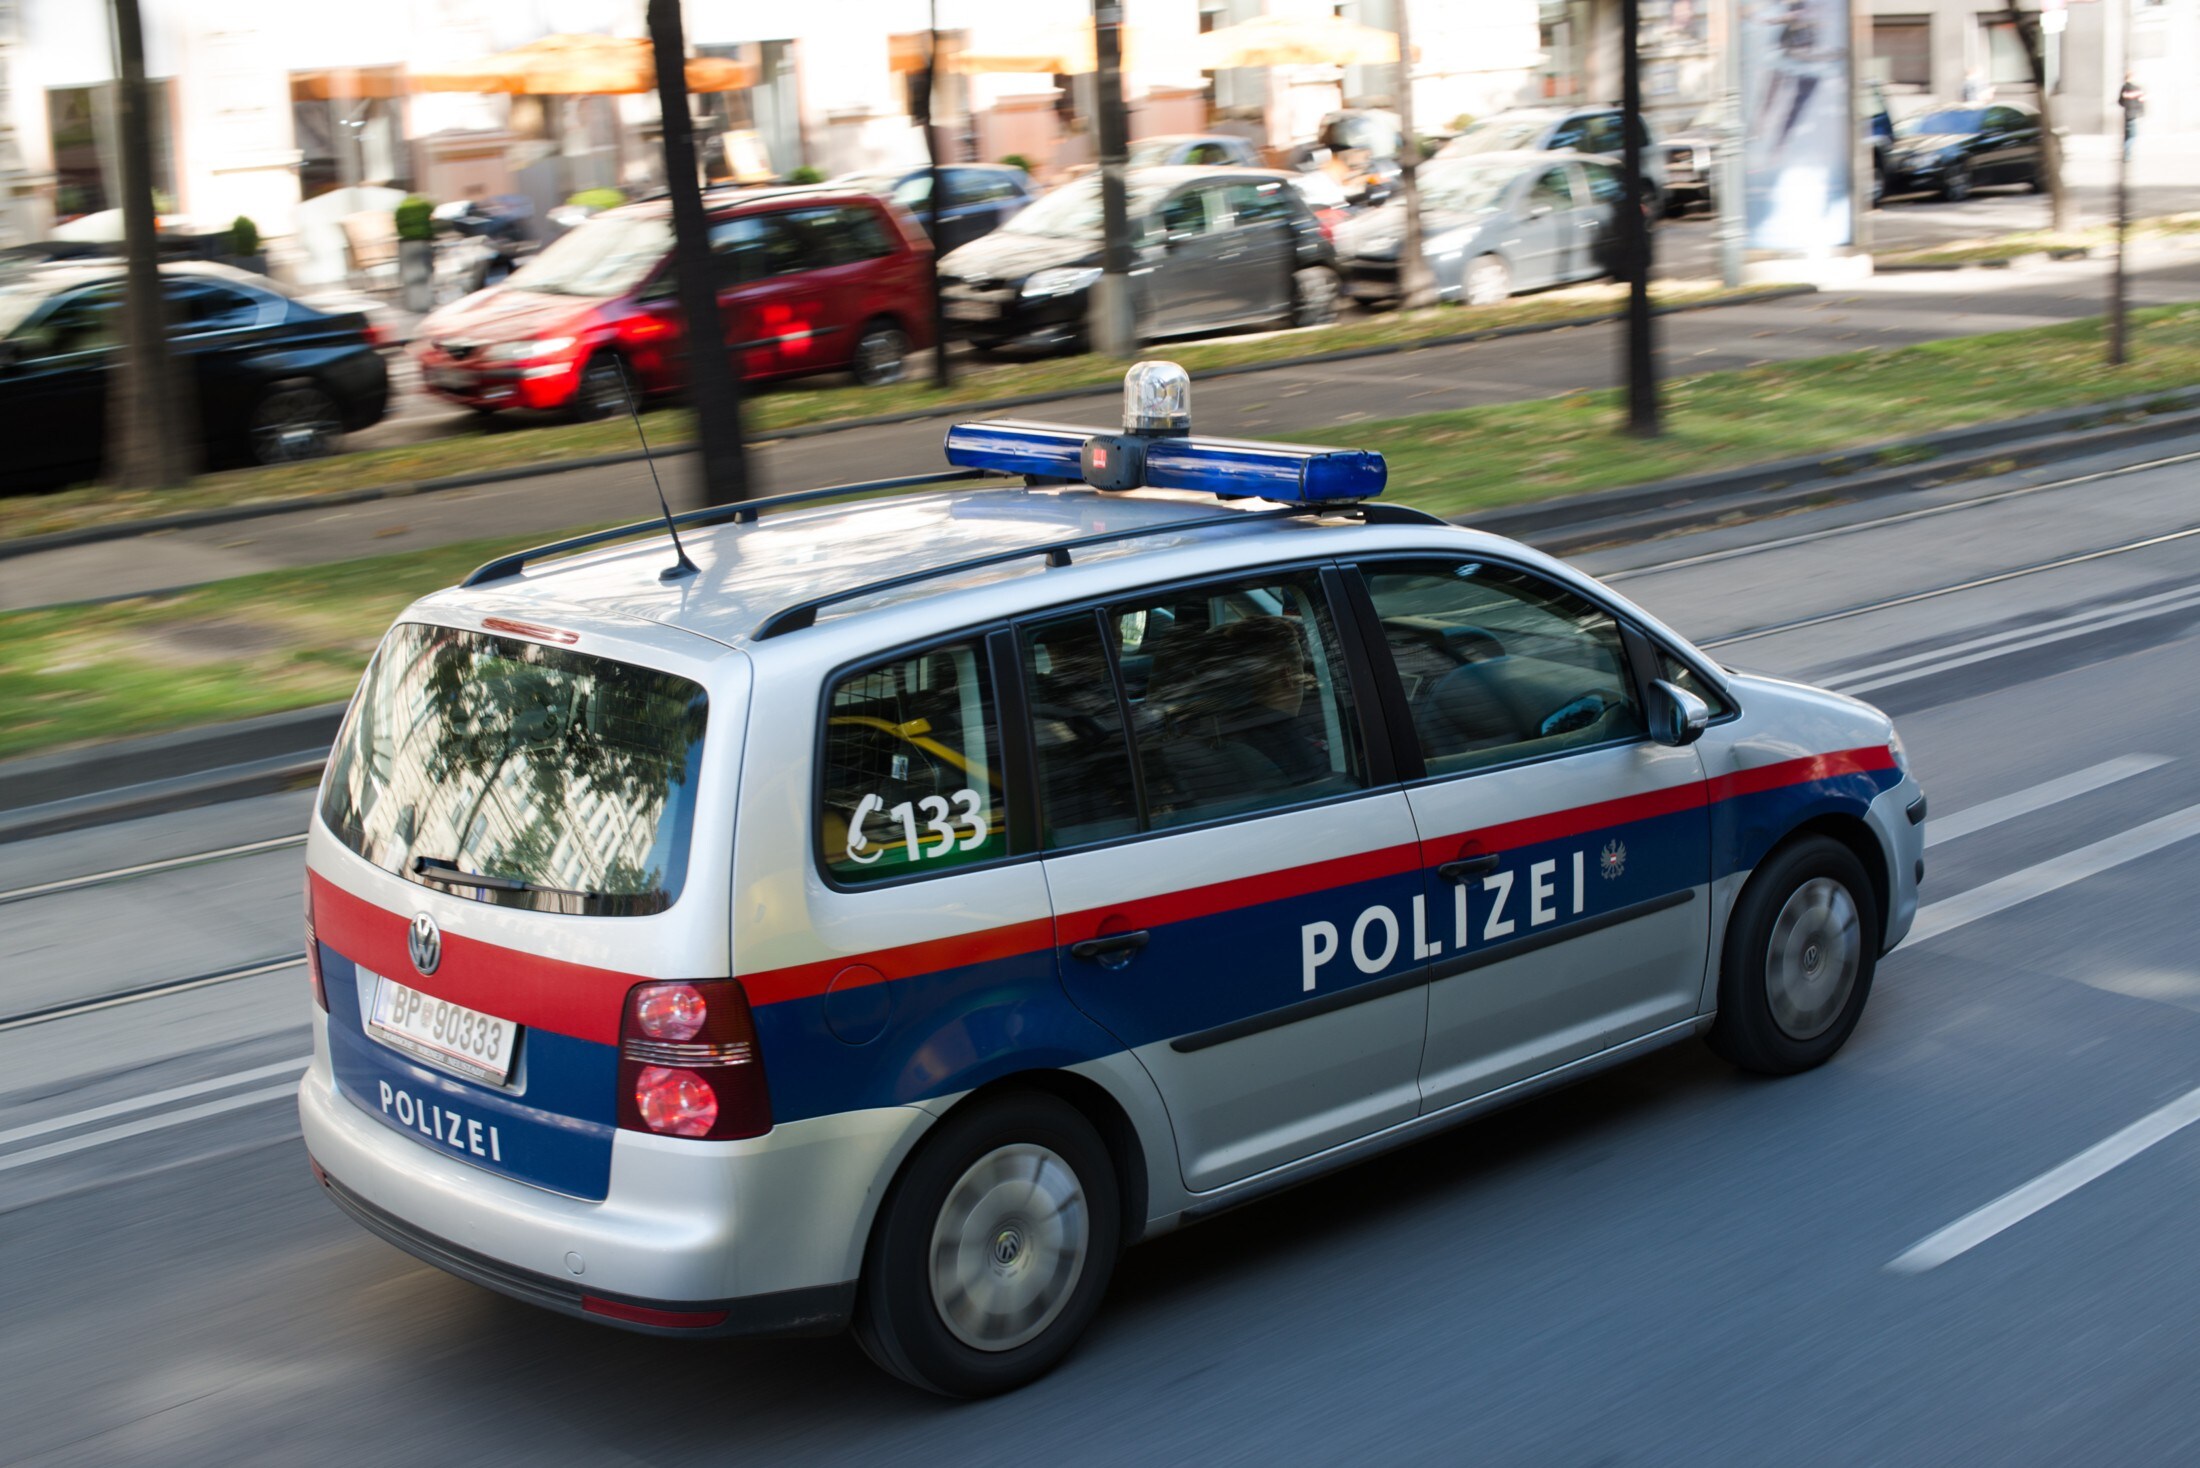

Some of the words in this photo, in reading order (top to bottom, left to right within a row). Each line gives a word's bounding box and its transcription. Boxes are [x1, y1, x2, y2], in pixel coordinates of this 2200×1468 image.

[890, 788, 987, 861] 133
[1301, 851, 1584, 992] POLIZEI
[393, 986, 421, 1028] BP
[433, 1001, 502, 1060] 90333
[379, 1080, 501, 1162] POLIZEI
